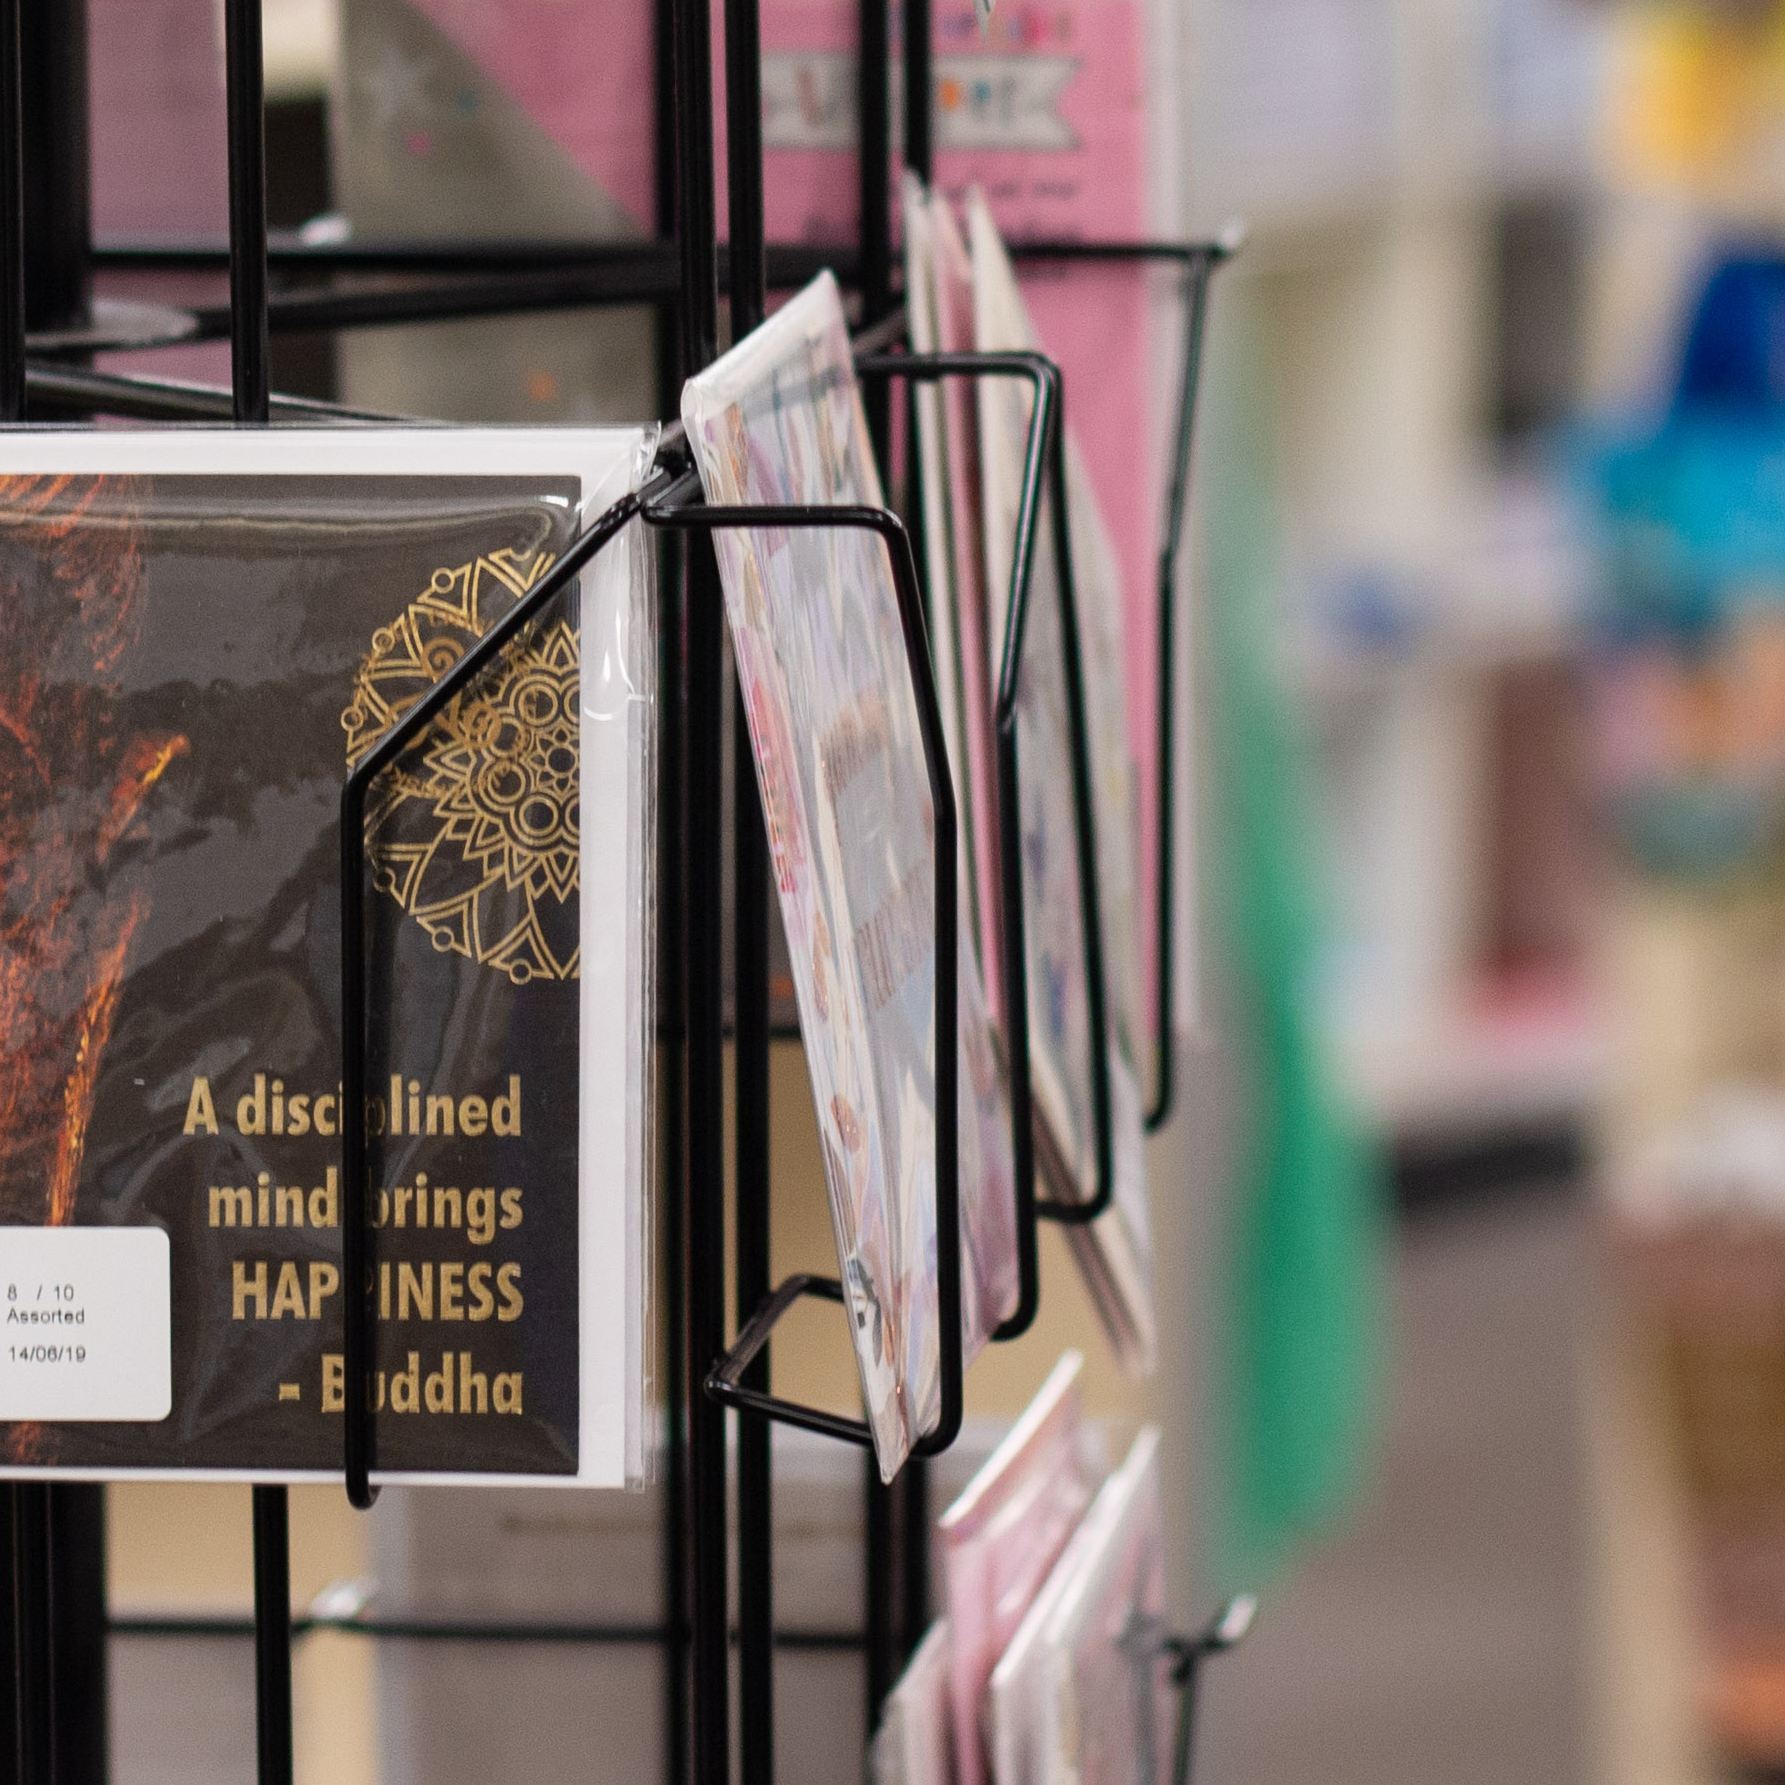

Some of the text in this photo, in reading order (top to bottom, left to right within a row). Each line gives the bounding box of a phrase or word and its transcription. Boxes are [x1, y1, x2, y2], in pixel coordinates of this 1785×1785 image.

[182, 1075, 220, 1136] A
[208, 1165, 339, 1229] mind
[6, 1282, 18, 1302] 8
[54, 1282, 75, 1302] 10
[231, 1260, 525, 1322] HAPINESS
[6, 1306, 85, 1325] Assorted
[8, 1344, 87, 1363] 14/06/19
